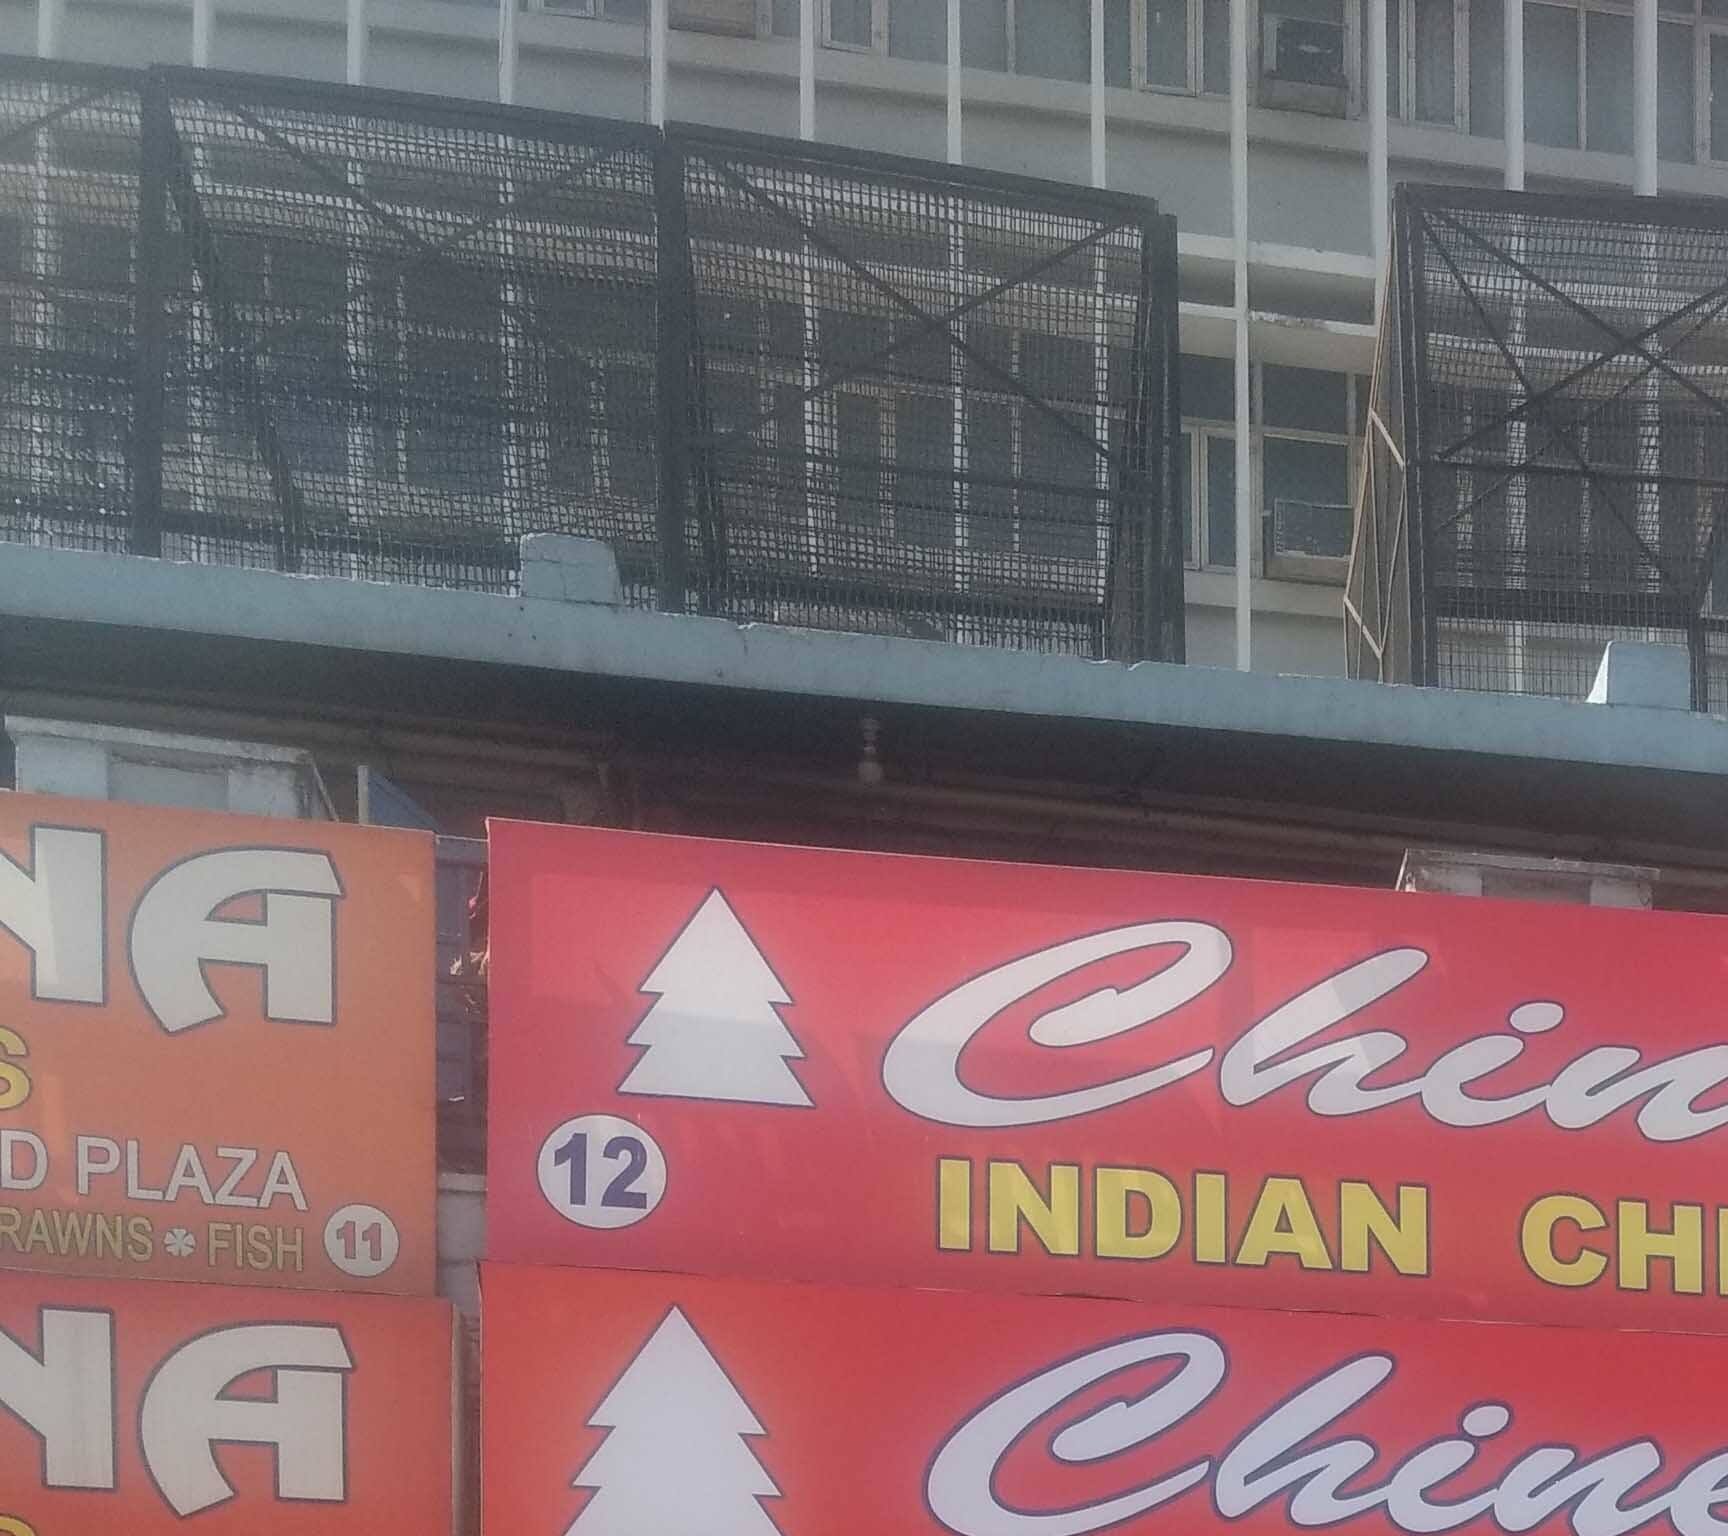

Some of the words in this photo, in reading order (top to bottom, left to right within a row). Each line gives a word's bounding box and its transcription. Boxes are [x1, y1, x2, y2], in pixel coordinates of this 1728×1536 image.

[77, 1135, 308, 1211] PLAZA
[553, 1132, 648, 1211] 12
[208, 1219, 304, 1273] FISH
[335, 1222, 382, 1260] 11
[937, 1156, 1428, 1277] INDIAN
